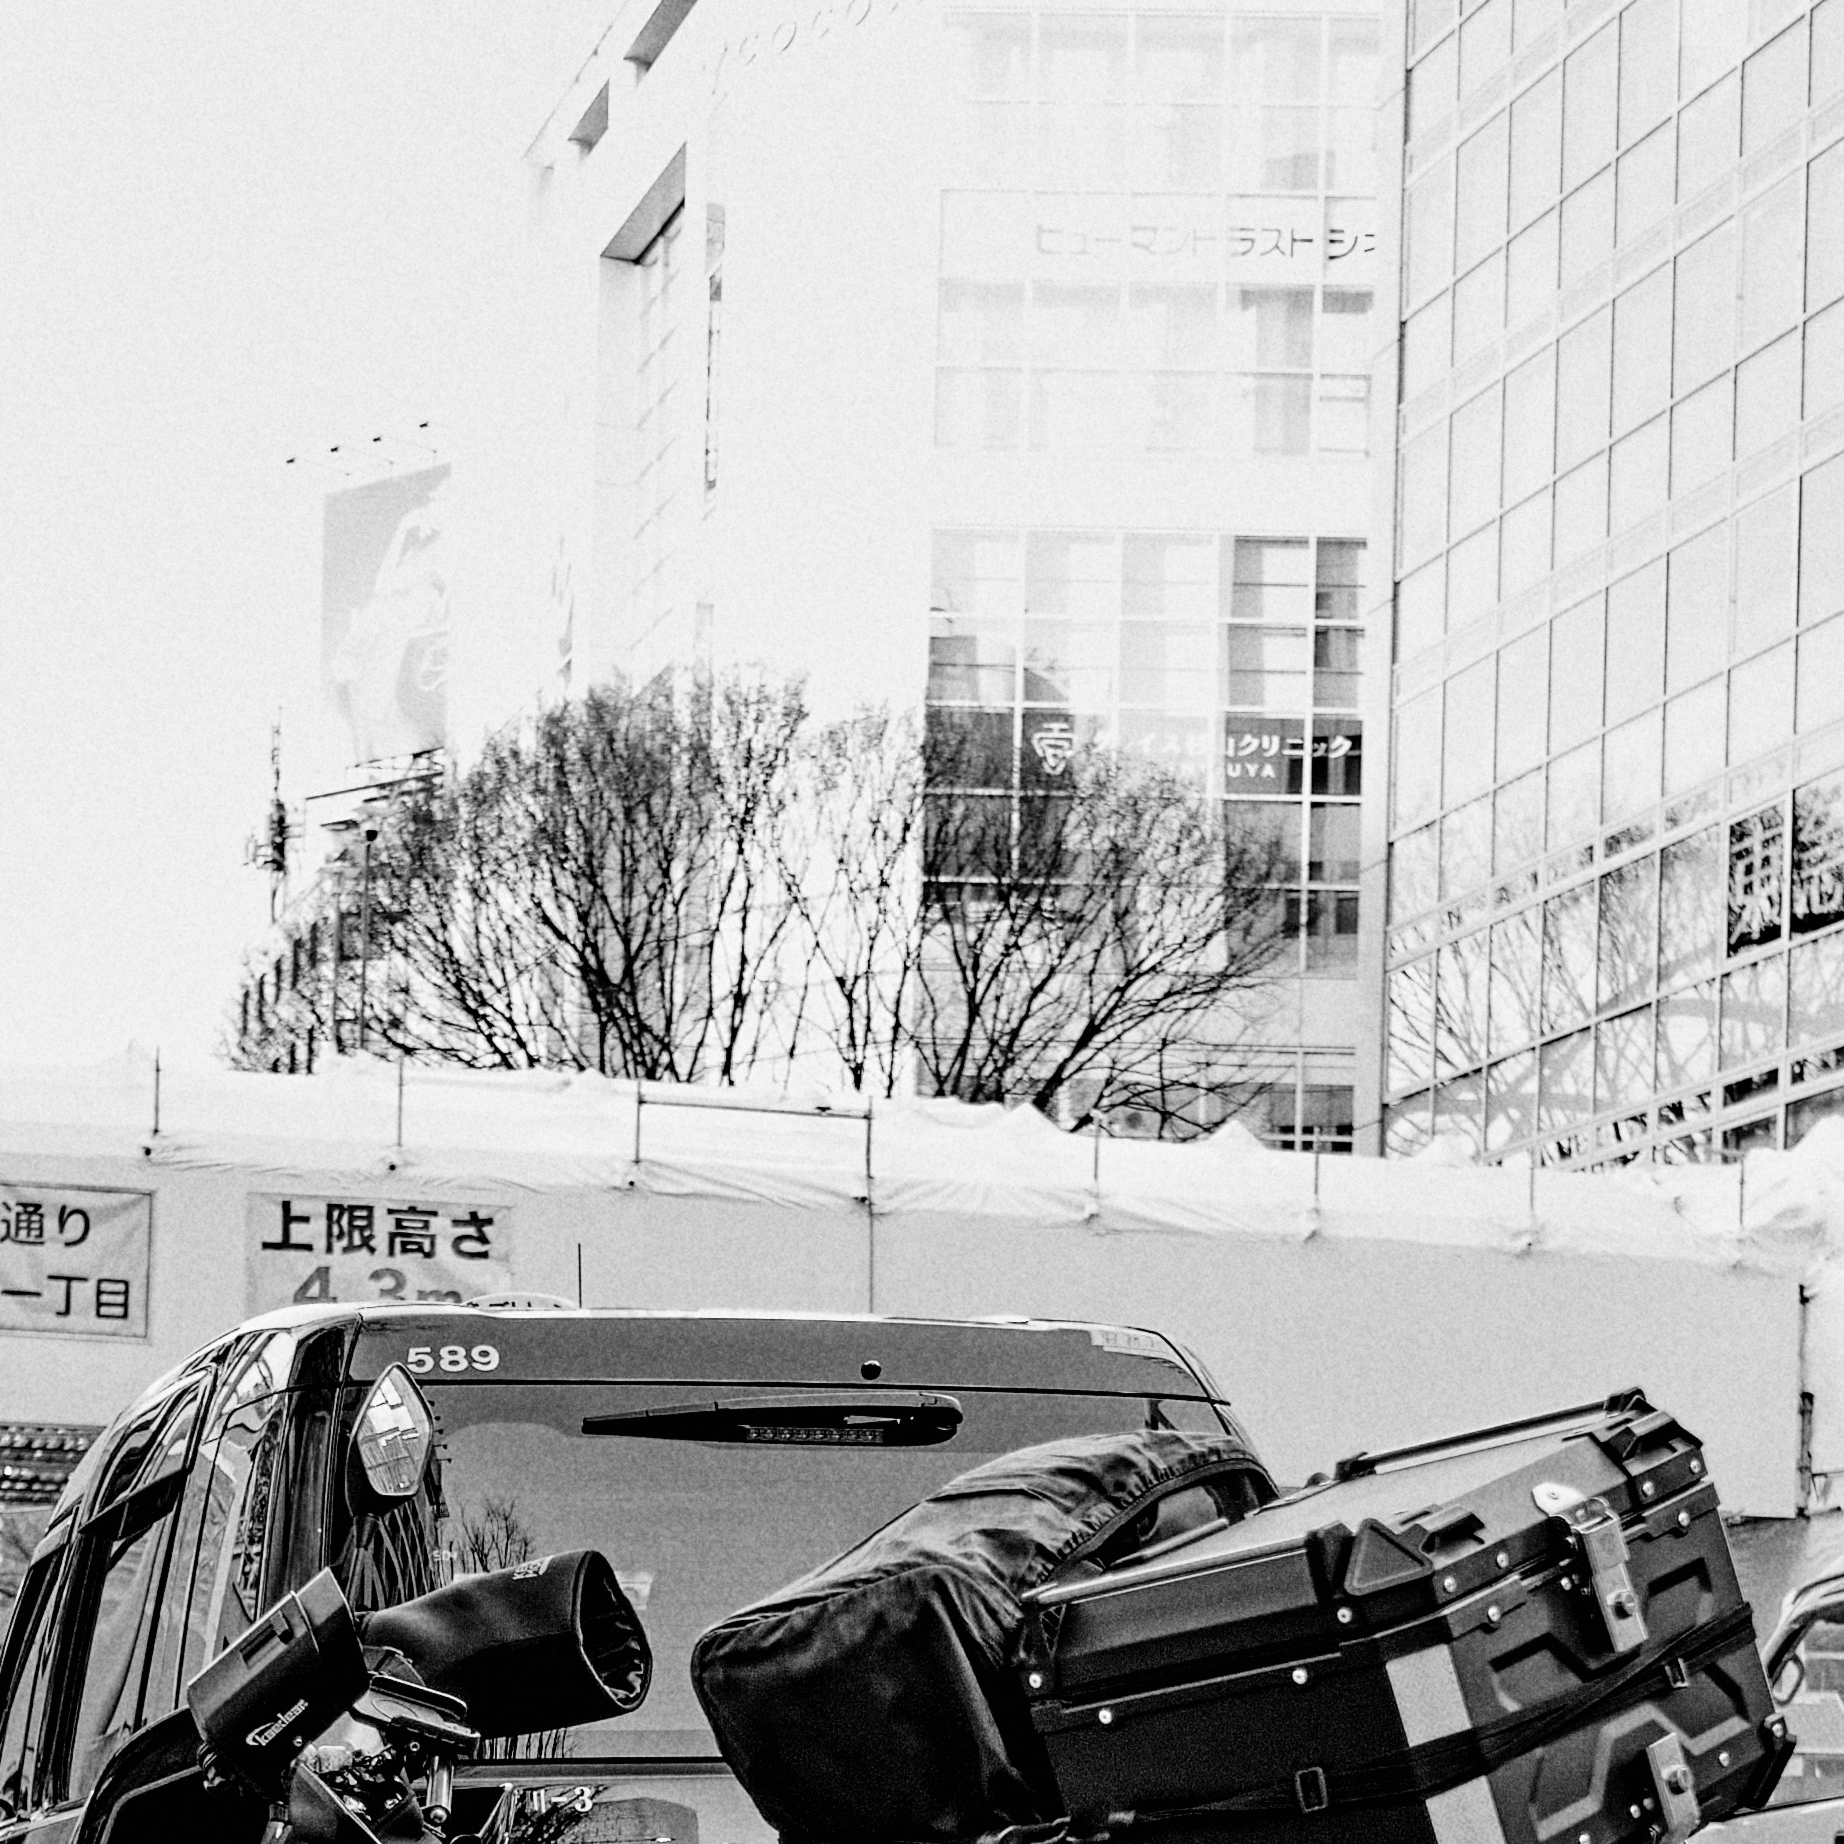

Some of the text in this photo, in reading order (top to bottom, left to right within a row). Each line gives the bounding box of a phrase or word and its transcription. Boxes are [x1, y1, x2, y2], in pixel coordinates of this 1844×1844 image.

[261, 1200, 495, 1260] 上限高さ
[405, 1344, 500, 1375] 589
